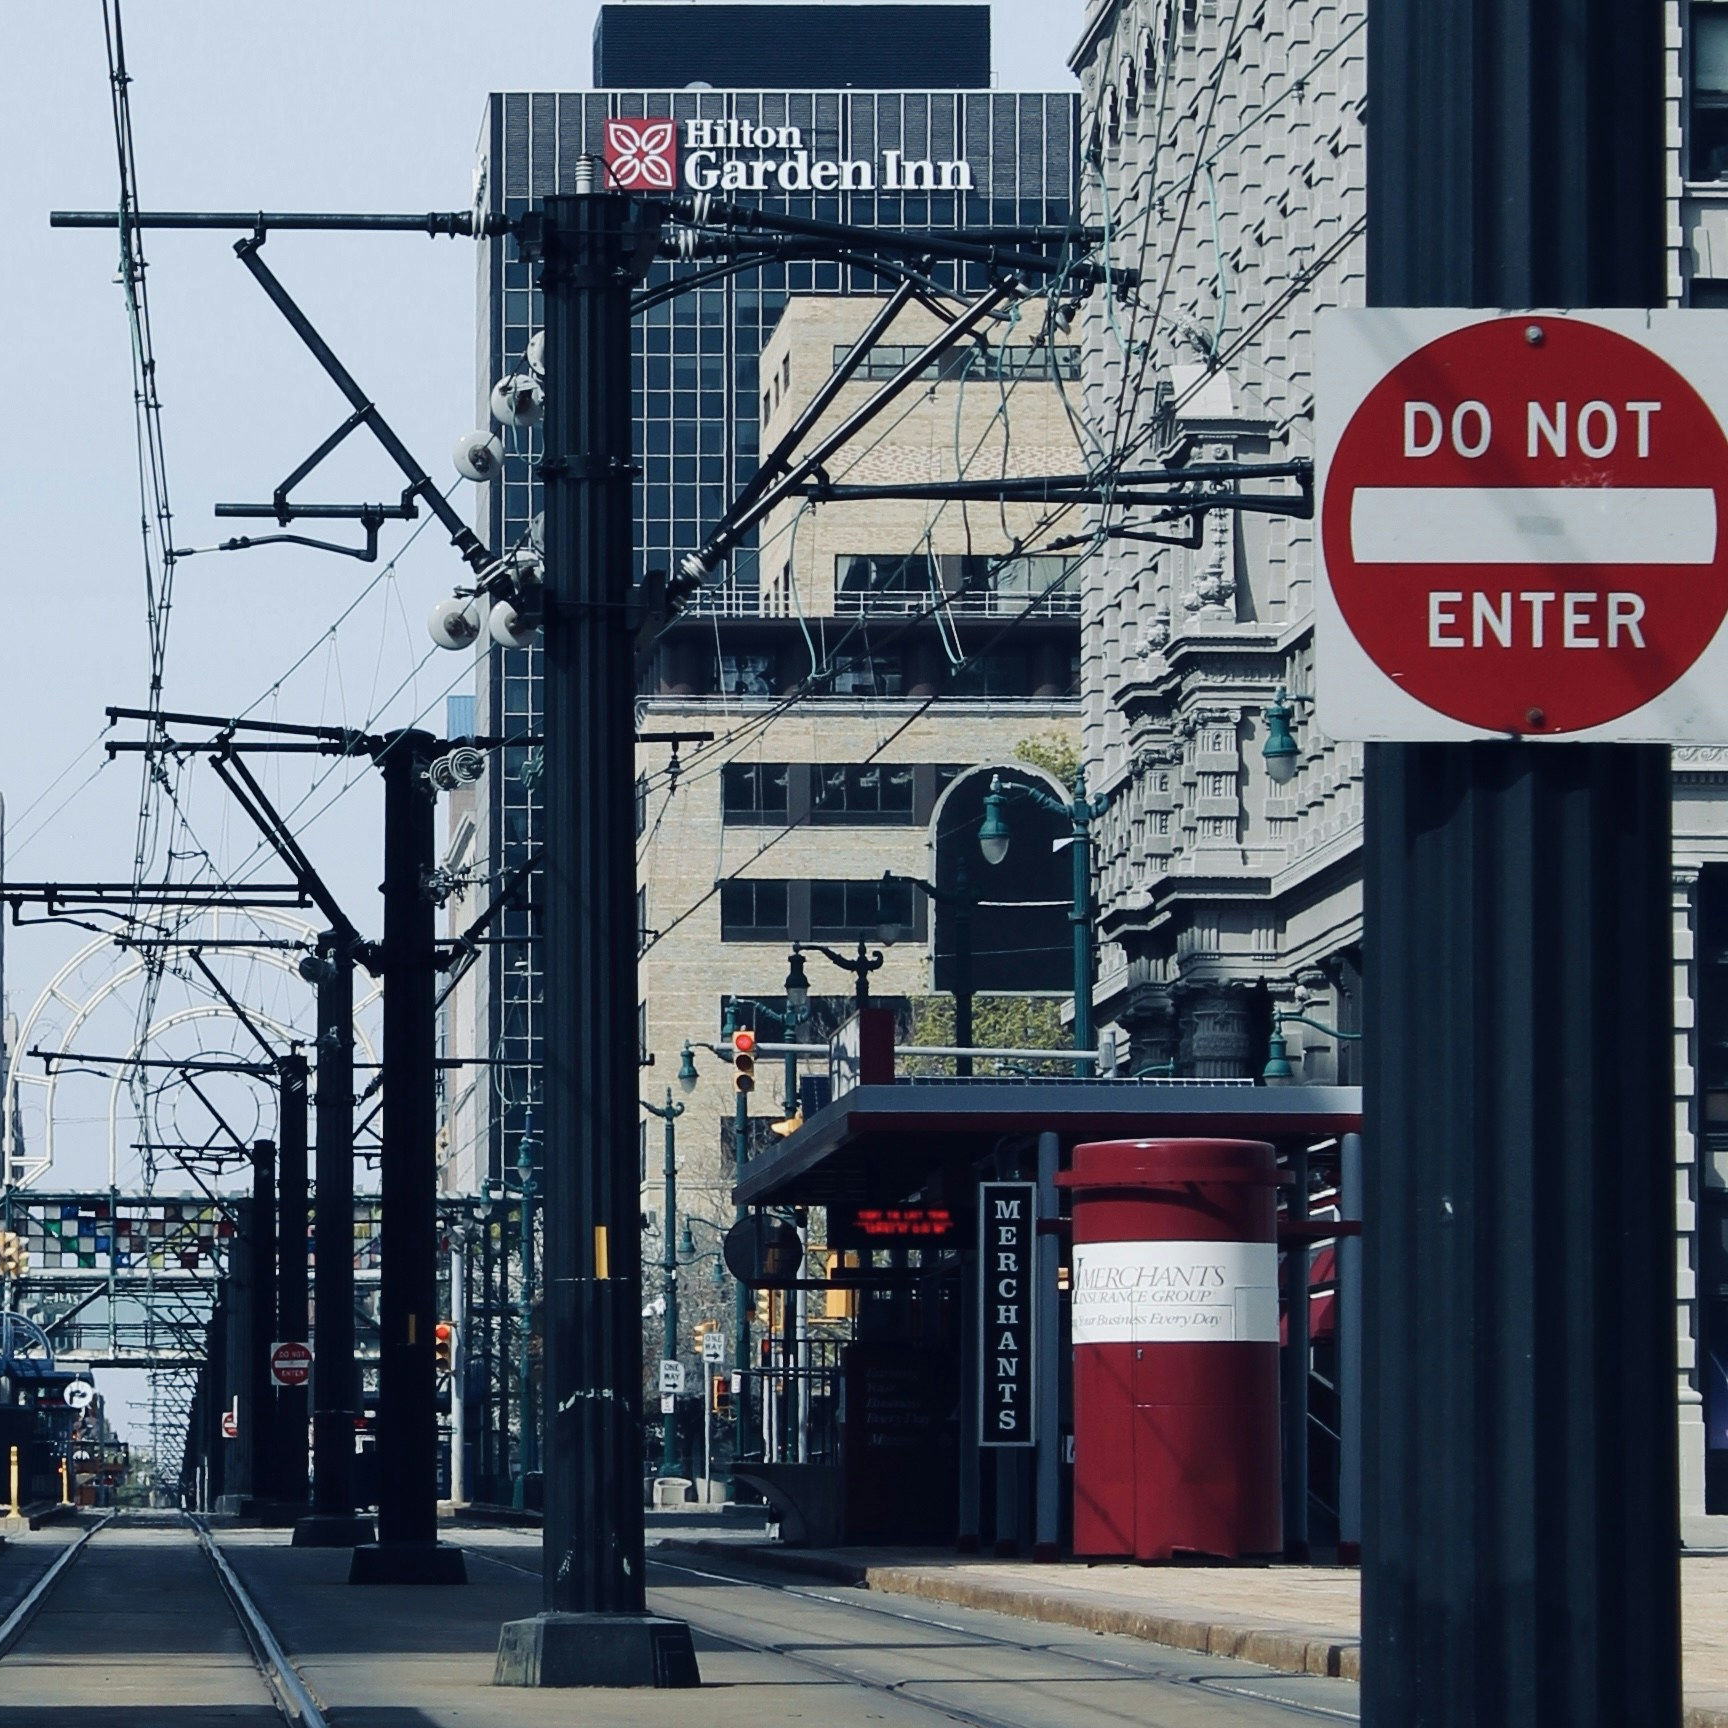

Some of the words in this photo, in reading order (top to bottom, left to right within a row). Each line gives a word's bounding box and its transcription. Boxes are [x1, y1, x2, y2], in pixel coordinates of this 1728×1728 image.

[684, 119, 803, 148] Hilton
[684, 150, 875, 190] Garden
[882, 150, 974, 190] Inn
[1404, 400, 1492, 459] DO
[1527, 400, 1662, 459] NOT
[1428, 591, 1647, 648] ENTER
[1080, 1265, 1227, 1289] MERCHANTS
[1151, 1290, 1212, 1303] GROUP
[994, 1200, 1021, 1430] MERCHANTS
[1149, 1313, 1193, 1328] Every
[1192, 1313, 1223, 1328] Day
